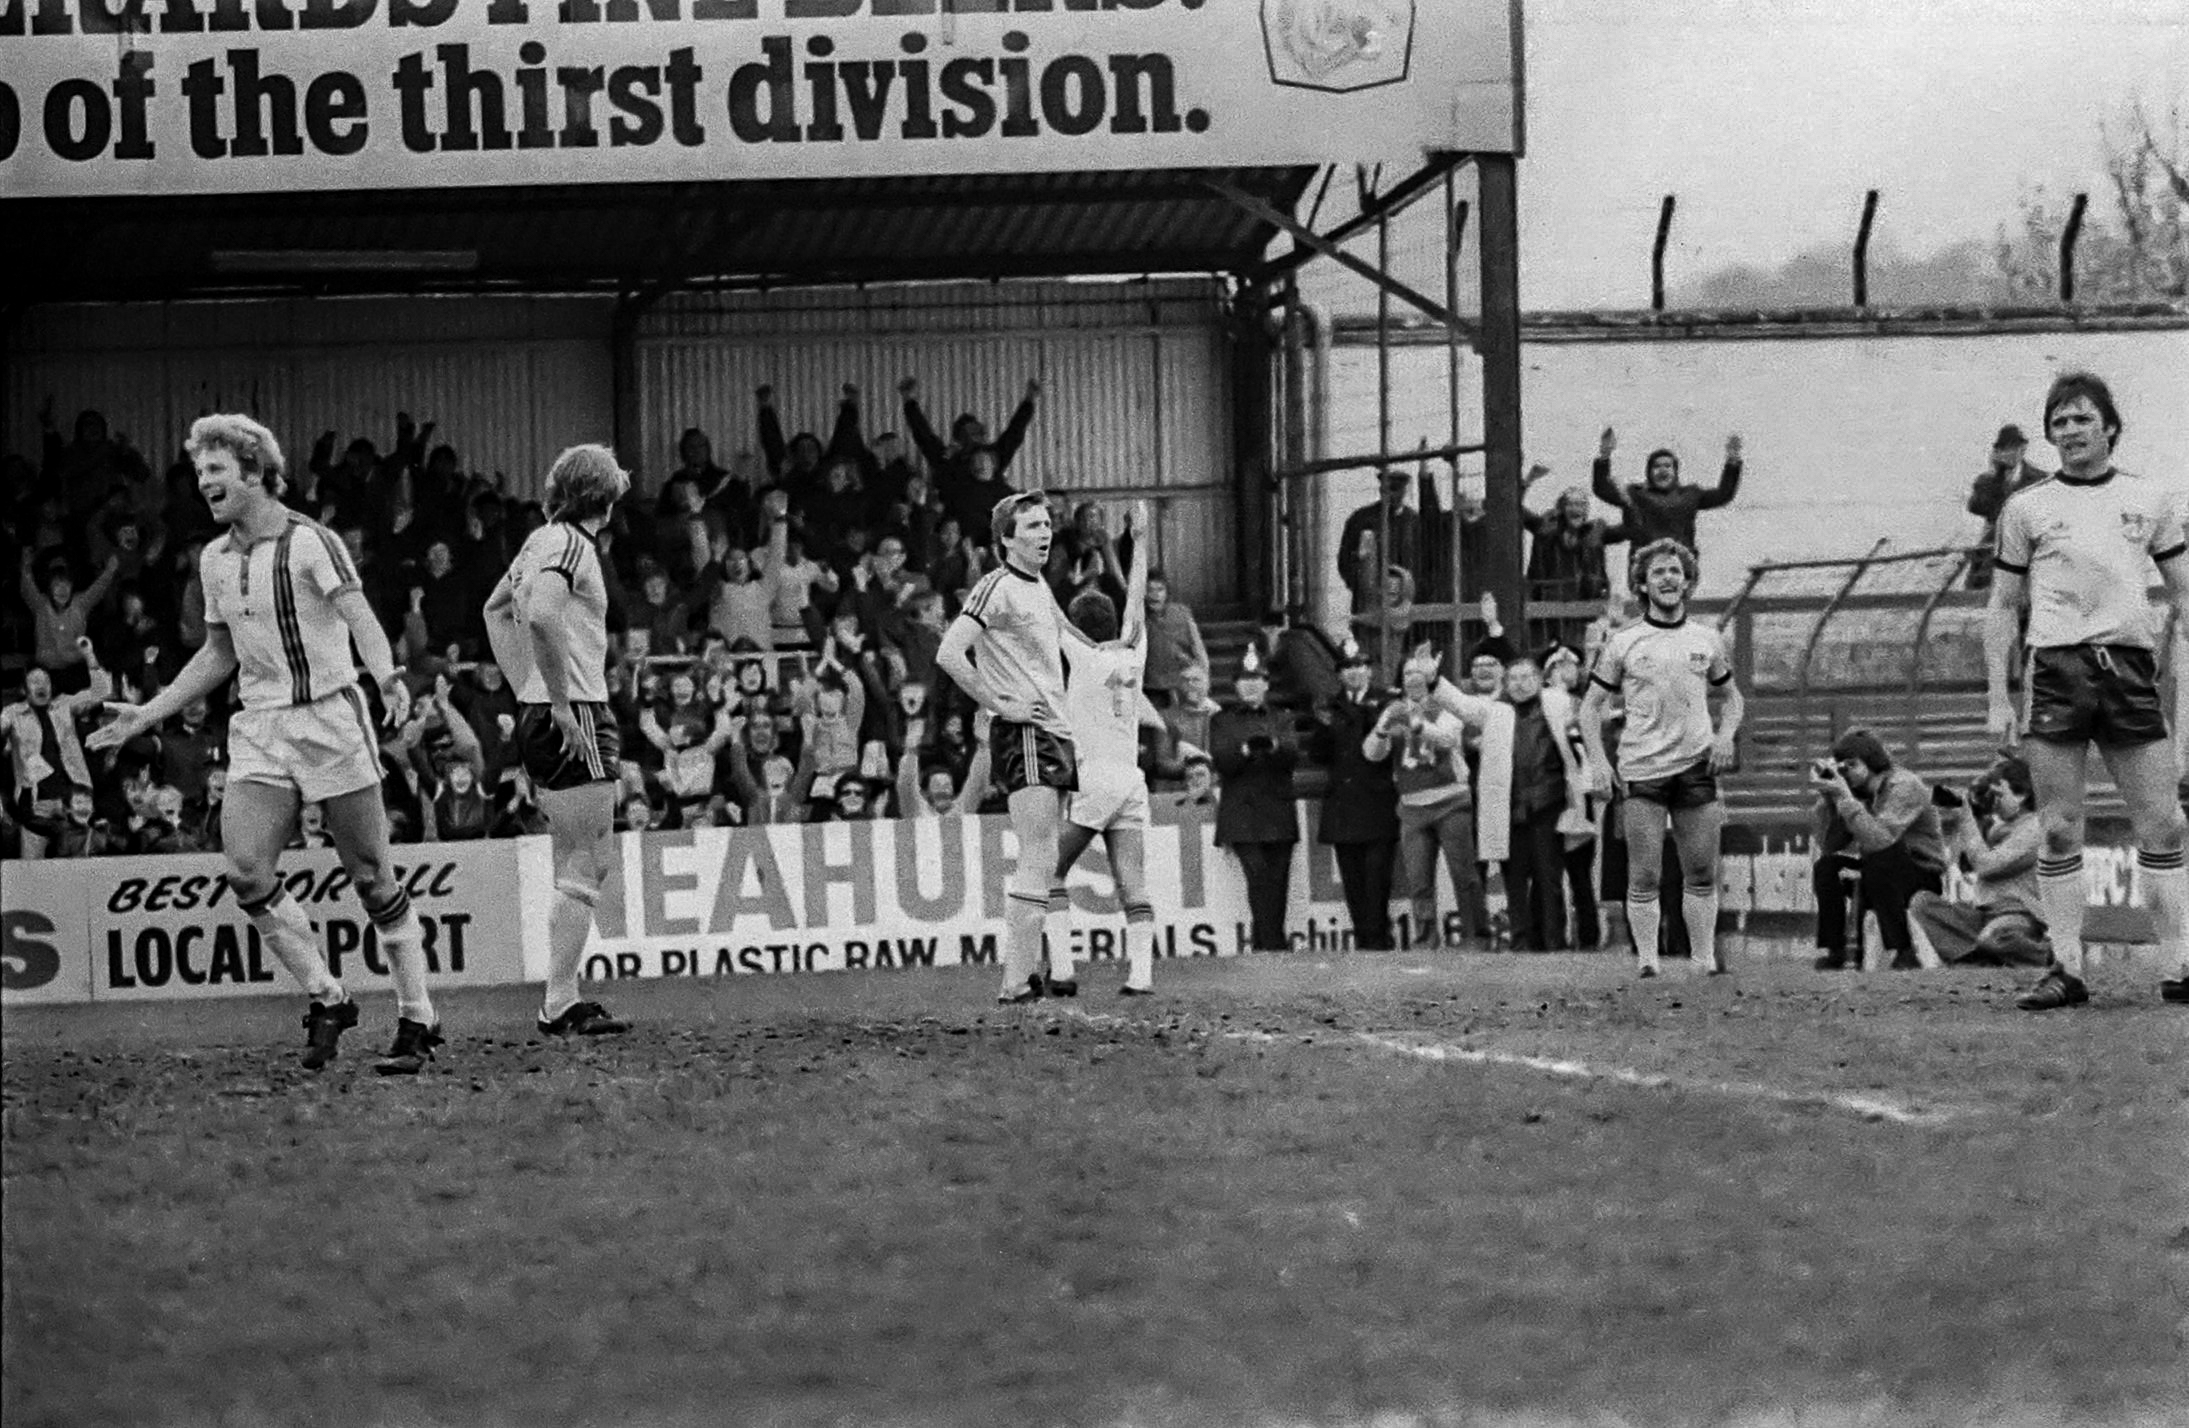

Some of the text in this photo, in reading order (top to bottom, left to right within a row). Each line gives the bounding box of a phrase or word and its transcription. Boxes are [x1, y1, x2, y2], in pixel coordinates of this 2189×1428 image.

[43, 50, 155, 161] of
[182, 48, 368, 159] the
[393, 40, 704, 153] thirst
[727, 31, 1211, 145] division.
[107, 862, 456, 913] BEST OR LL
[107, 912, 472, 988] LOCAL PORT
[577, 951, 643, 980] OR
[844, 936, 938, 970] RAW
[960, 924, 1218, 966] MERILS
